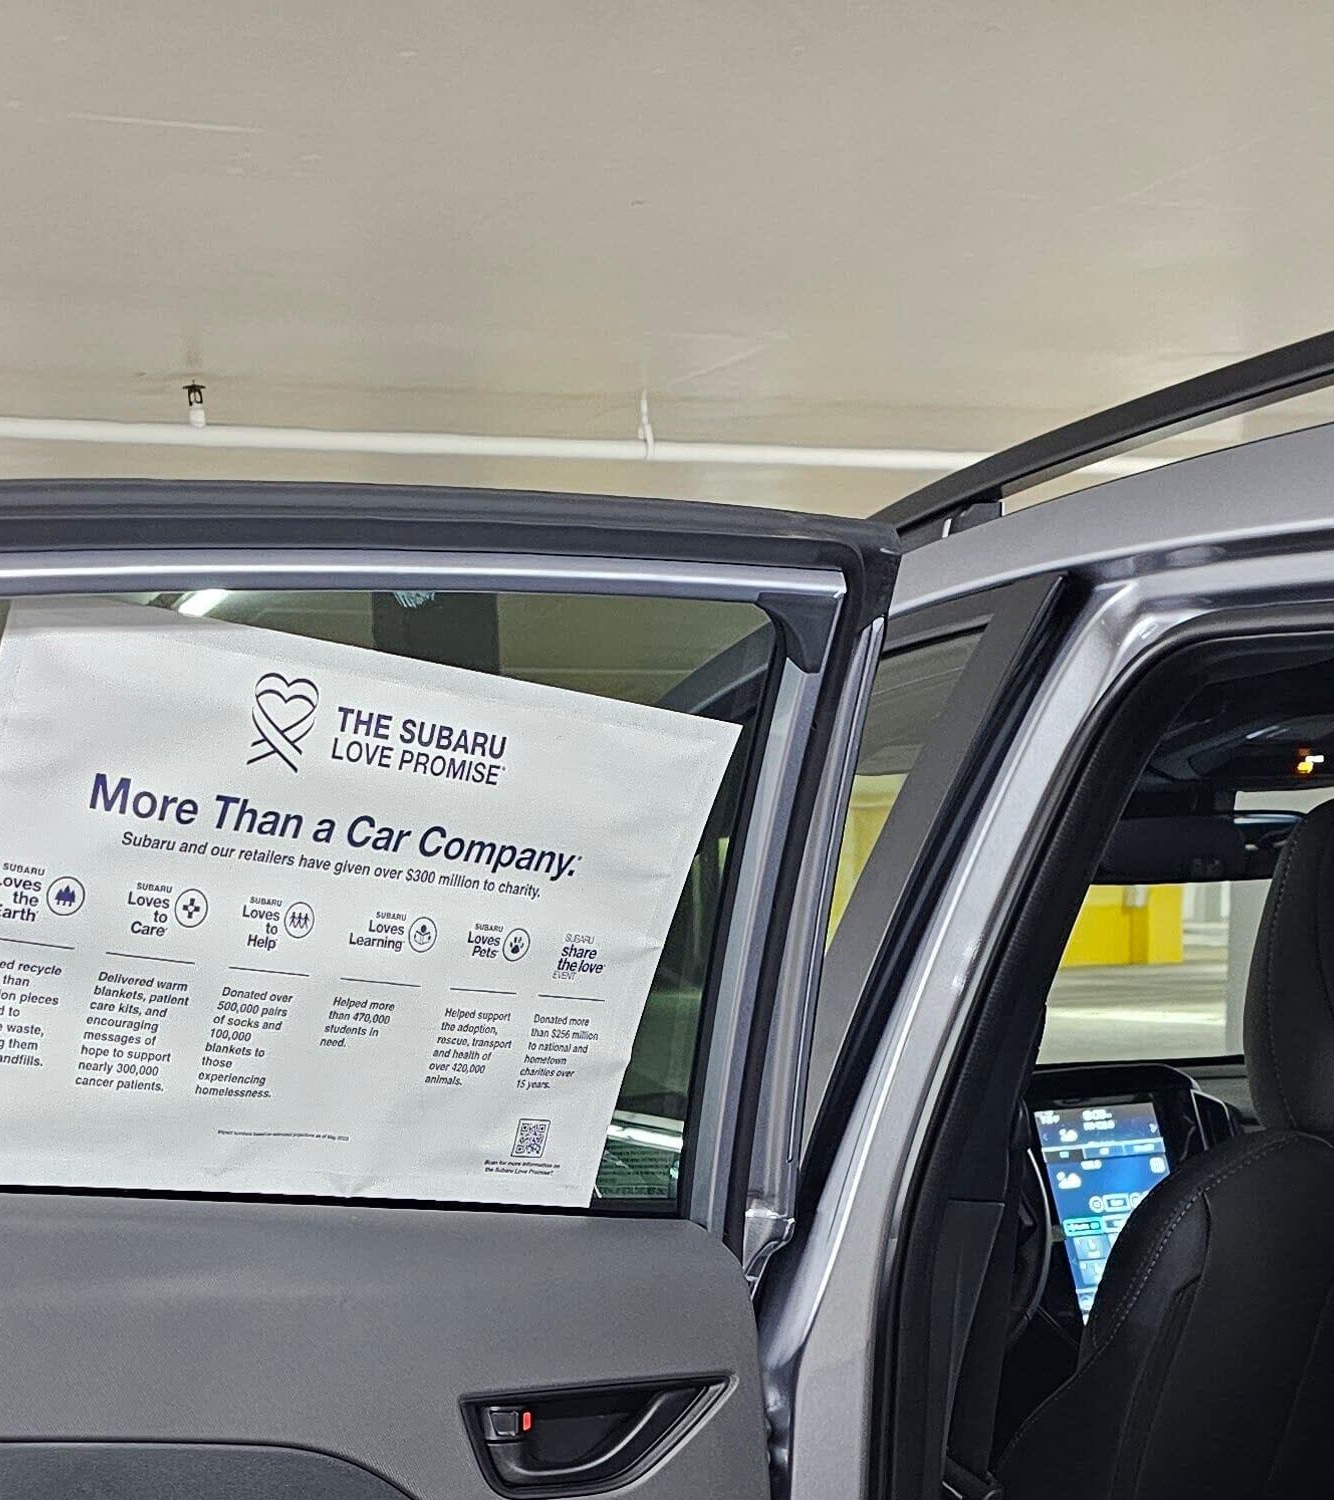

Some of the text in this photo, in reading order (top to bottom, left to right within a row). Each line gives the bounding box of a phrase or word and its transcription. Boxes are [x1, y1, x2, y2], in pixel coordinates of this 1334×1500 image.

[338, 706, 507, 759] THE SUBARU
[331, 737, 504, 785] LOVE PROMISE
[89, 773, 580, 882] More Than a Car Company.
[3, 862, 45, 876] SUBARU
[121, 831, 540, 900] Subaru and our retailers have given over $300 million to charity.
[137, 882, 173, 894] SUBARU
[13, 891, 39, 907] the
[128, 891, 170, 909] Loves
[250, 896, 283, 907] SUBARU
[154, 910, 168, 923] to
[242, 905, 280, 921] Loves
[376, 911, 407, 921] SUBARU
[131, 921, 165, 937] Care
[266, 922, 278, 935] to
[368, 919, 404, 935] Loves
[475, 923, 504, 933] SUBARU
[247, 934, 276, 951] Help
[349, 932, 403, 952] Learning
[467, 931, 501, 946] Loves
[472, 945, 498, 958] Pets
[561, 944, 597, 959] share
[18, 963, 62, 975] recycle
[557, 957, 603, 974] the love
[3, 974, 30, 987] than
[98, 971, 188, 991] Delivered warm
[552, 970, 577, 980] EVENT
[19, 992, 59, 1006] pieces
[93, 985, 189, 1006] blankets, patient
[222, 986, 293, 1003] Donated over
[90, 1001, 168, 1018] care kits, and
[217, 1001, 288, 1017] 500,000 pairs
[332, 996, 395, 1011] Helped more
[8, 1006, 20, 1017] to
[328, 1010, 390, 1024] than 470,000
[444, 1008, 511, 1022] Helped support
[86, 1016, 159, 1034] encouraging
[213, 1015, 283, 1031] of socks and
[533, 1013, 589, 1027] Donated more
[7, 1024, 44, 1038] waste,
[211, 1028, 252, 1042] 100,000
[324, 1024, 379, 1037] students in
[441, 1022, 498, 1036] the adoption,
[531, 1028, 598, 1041] than $256 million
[8, 1038, 38, 1050] them
[83, 1031, 157, 1046] messages of
[319, 1038, 346, 1047] need.
[436, 1037, 512, 1050] rescue, transport
[80, 1044, 171, 1063] hope to support
[205, 1042, 265, 1057] blankets to
[528, 1041, 589, 1054] to national and
[202, 1056, 233, 1068] those
[432, 1049, 492, 1061] and health of
[524, 1054, 567, 1065] hometown
[78, 1061, 159, 1076] nearly 300,000
[520, 1067, 555, 1077] charities
[75, 1077, 164, 1092] cancer patients.
[198, 1072, 266, 1087] experiencing
[425, 1075, 462, 1086] animals.
[516, 1079, 550, 1091] 15 years.
[195, 1084, 271, 1098] homelessness.
